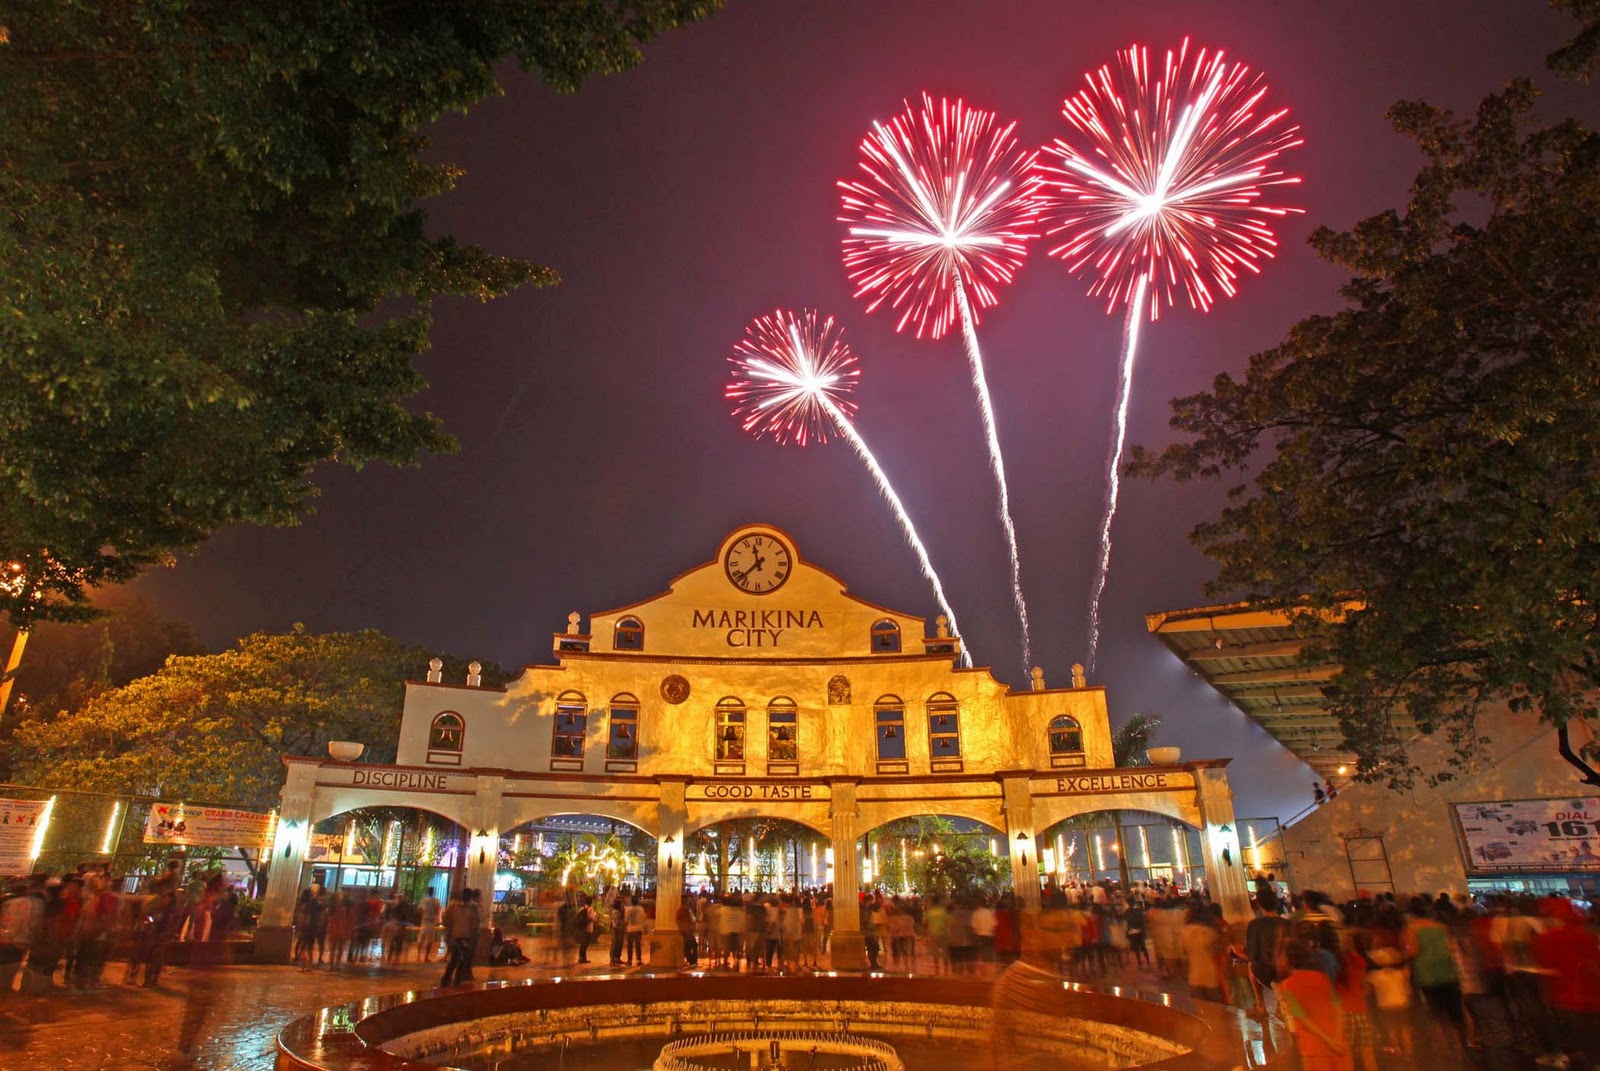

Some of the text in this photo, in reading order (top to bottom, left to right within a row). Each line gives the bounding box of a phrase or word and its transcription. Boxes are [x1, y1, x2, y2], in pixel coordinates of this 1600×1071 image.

[692, 609, 824, 629] MARIKINA
[726, 628, 785, 648] CITY
[352, 770, 448, 790] DISCIPLINE
[1057, 774, 1168, 792] EXCELLENCE
[704, 785, 812, 798] GOOD TASTE
[204, 809, 233, 818] GRAND
[1555, 811, 1594, 821] DIAL
